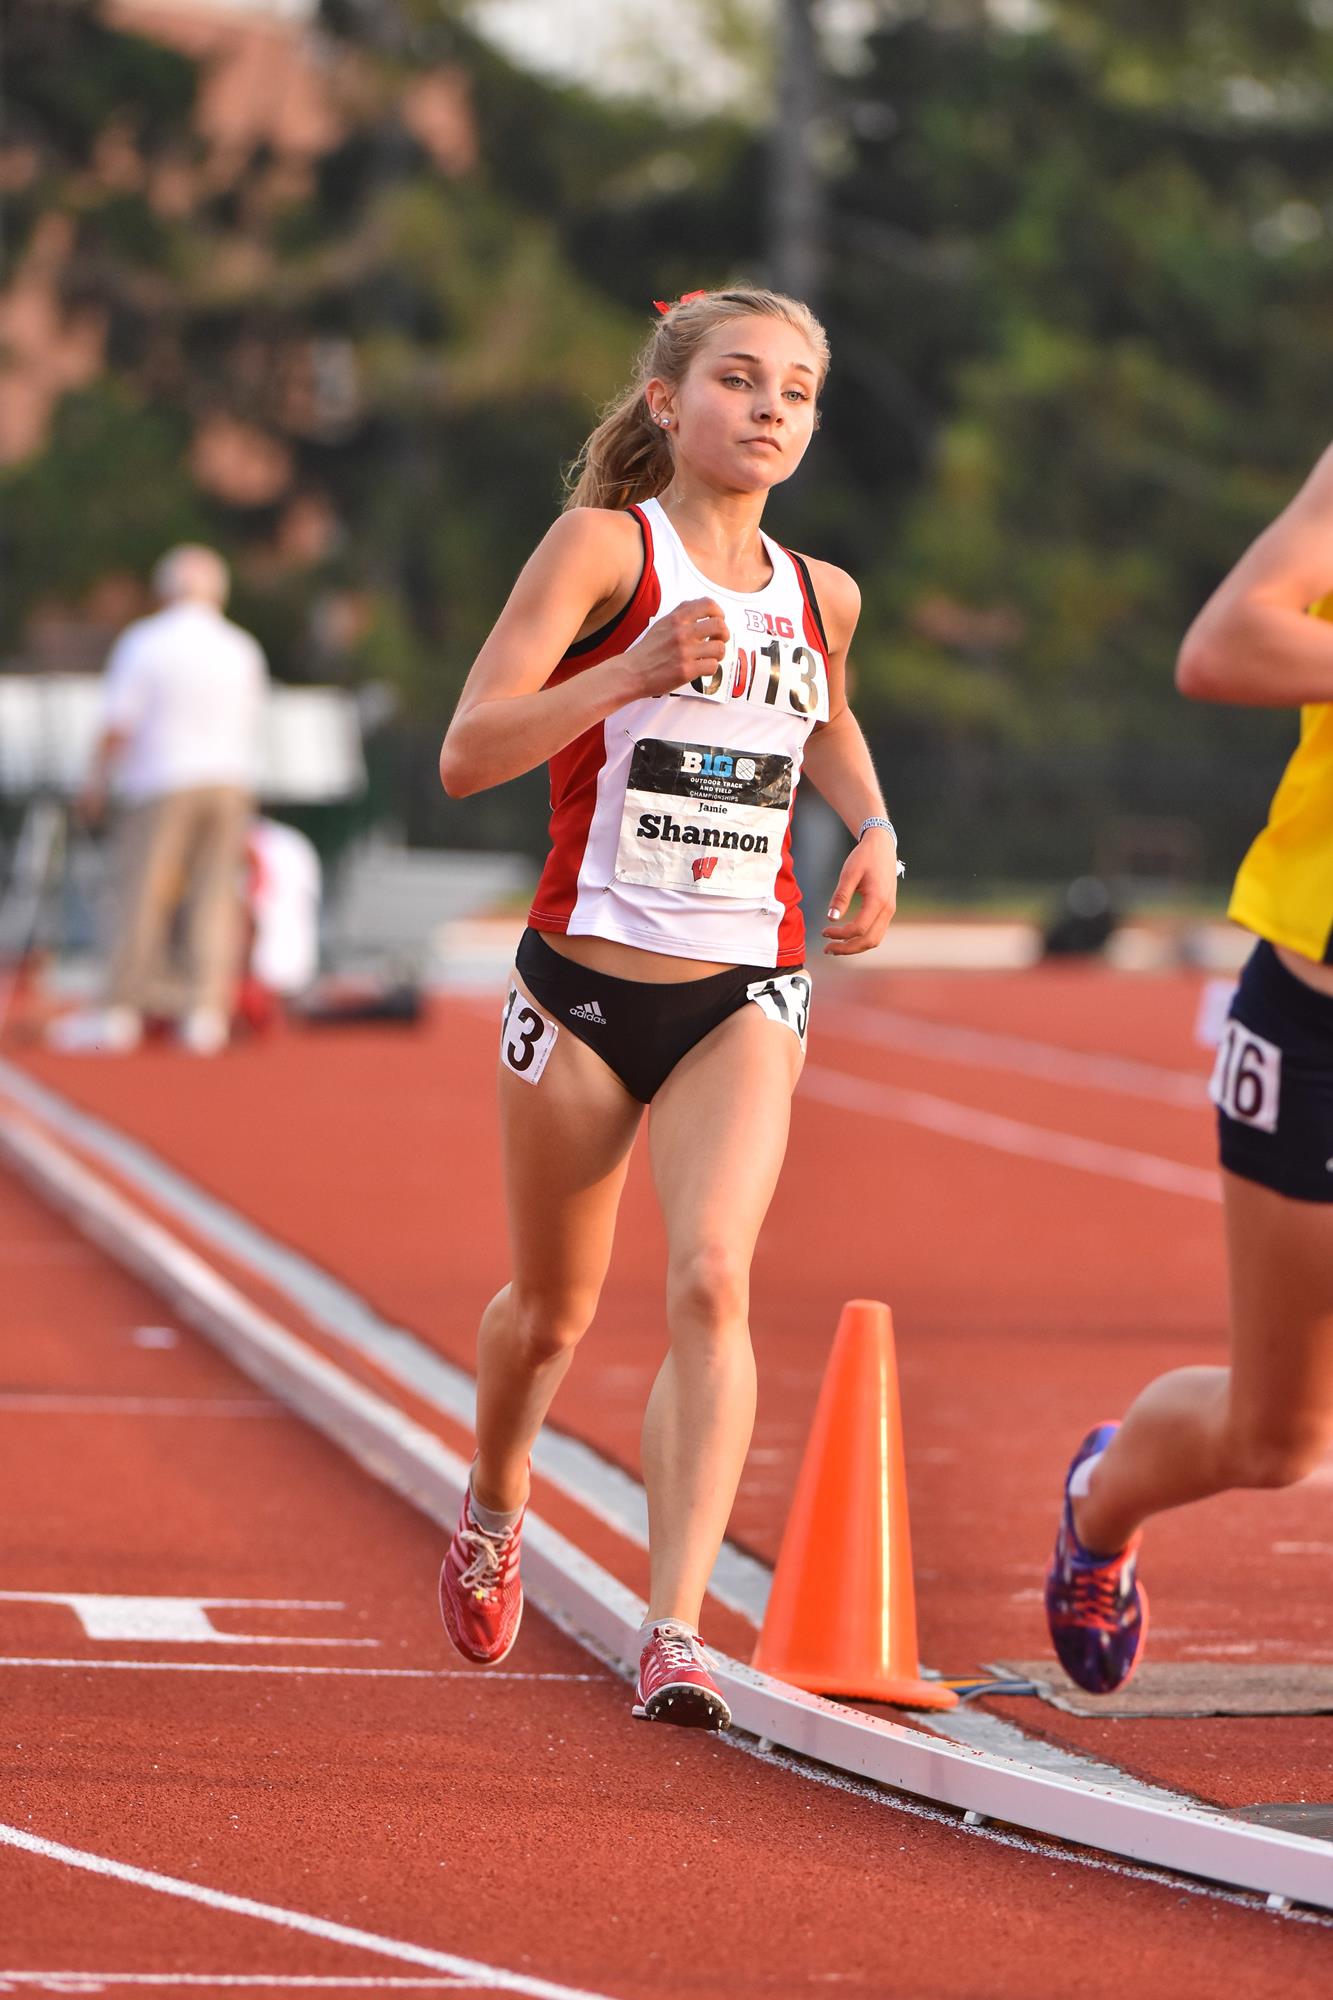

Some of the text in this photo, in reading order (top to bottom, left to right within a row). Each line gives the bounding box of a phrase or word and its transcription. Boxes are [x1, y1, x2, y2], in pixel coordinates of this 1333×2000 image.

[760, 640, 819, 713] 13
[689, 790, 739, 802] CHAMPIONSHIPS
[690, 777, 743, 789] OUTDOOR TRACK
[698, 802, 728, 814] Jamie
[636, 813, 769, 854] Shannon
[691, 856, 719, 882] W
[569, 1007, 607, 1025] adidas
[753, 976, 810, 1039] 13
[1222, 1028, 1264, 1118] 16
